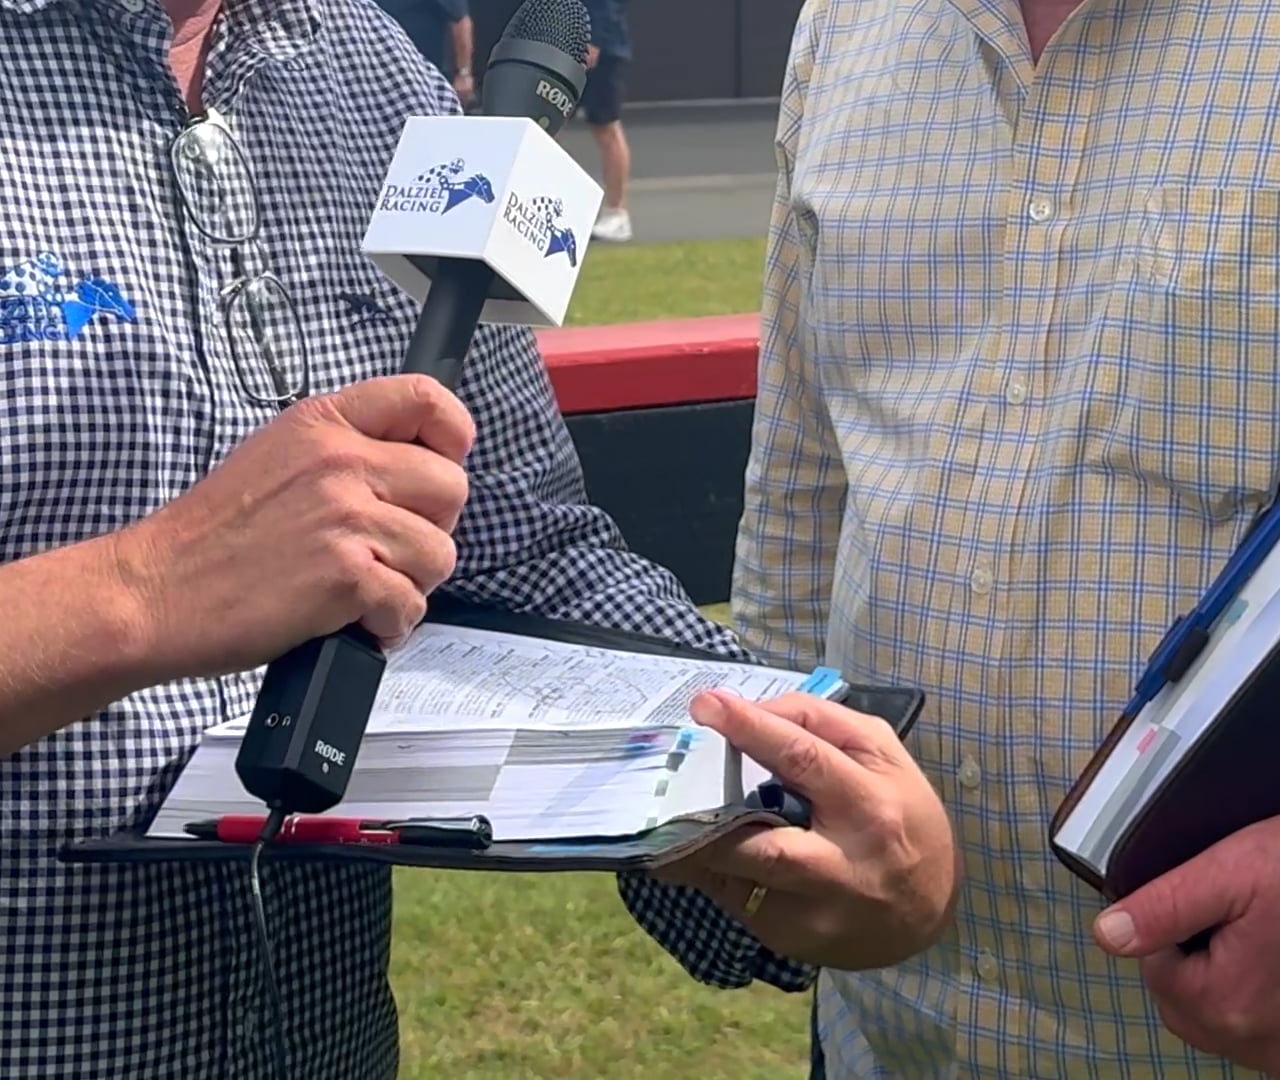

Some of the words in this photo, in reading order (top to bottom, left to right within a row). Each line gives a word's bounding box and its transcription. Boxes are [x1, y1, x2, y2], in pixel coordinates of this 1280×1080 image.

[380, 198, 441, 212] RACING
[384, 184, 445, 199] DALZIEL
[503, 205, 546, 252] RACING
[508, 191, 549, 240] DALZIEL
